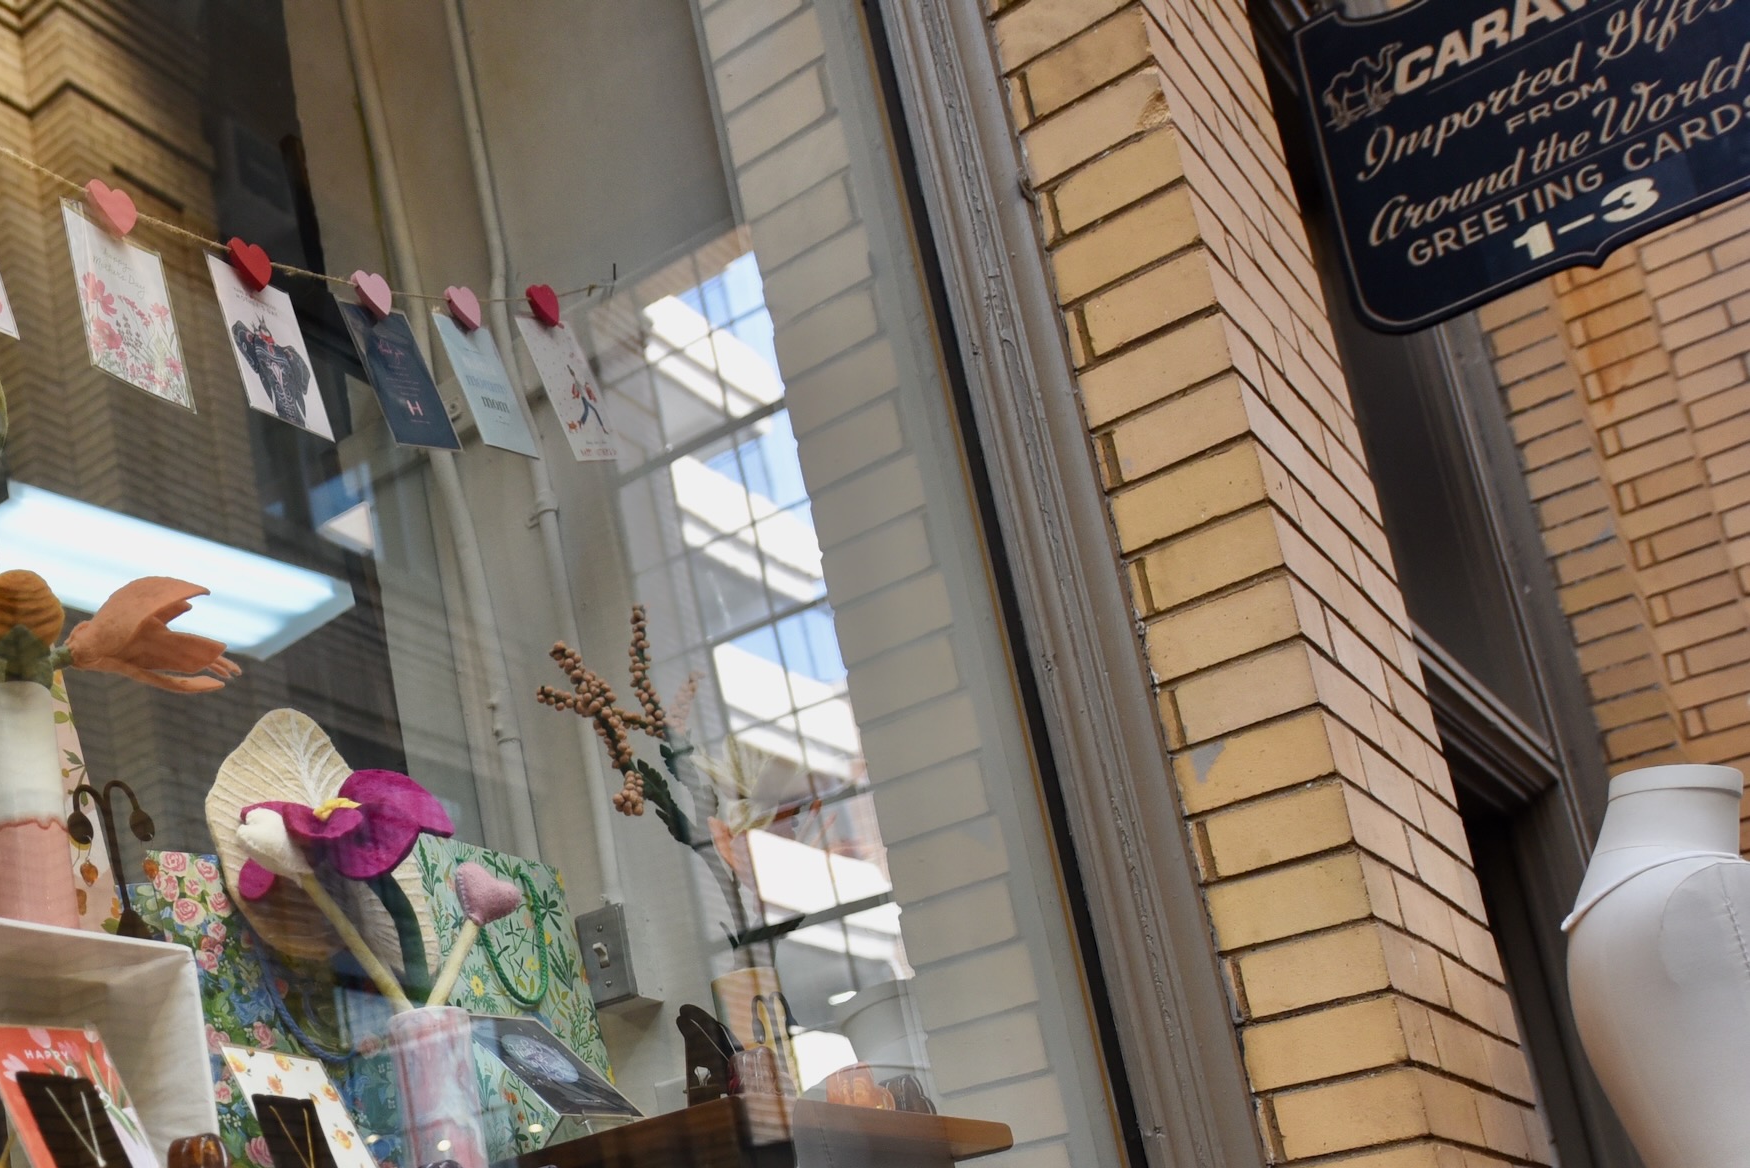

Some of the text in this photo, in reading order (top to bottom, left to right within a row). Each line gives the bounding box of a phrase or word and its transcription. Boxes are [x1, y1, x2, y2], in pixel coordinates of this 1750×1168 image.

[1394, 0, 1587, 95] CARA
[1356, 42, 1584, 181] Imported
[1368, 42, 1750, 247] Around the World
[1505, 76, 1608, 135] FROM
[1407, 164, 1604, 266] GREETING
[24, 1049, 70, 1061] HAPPY
